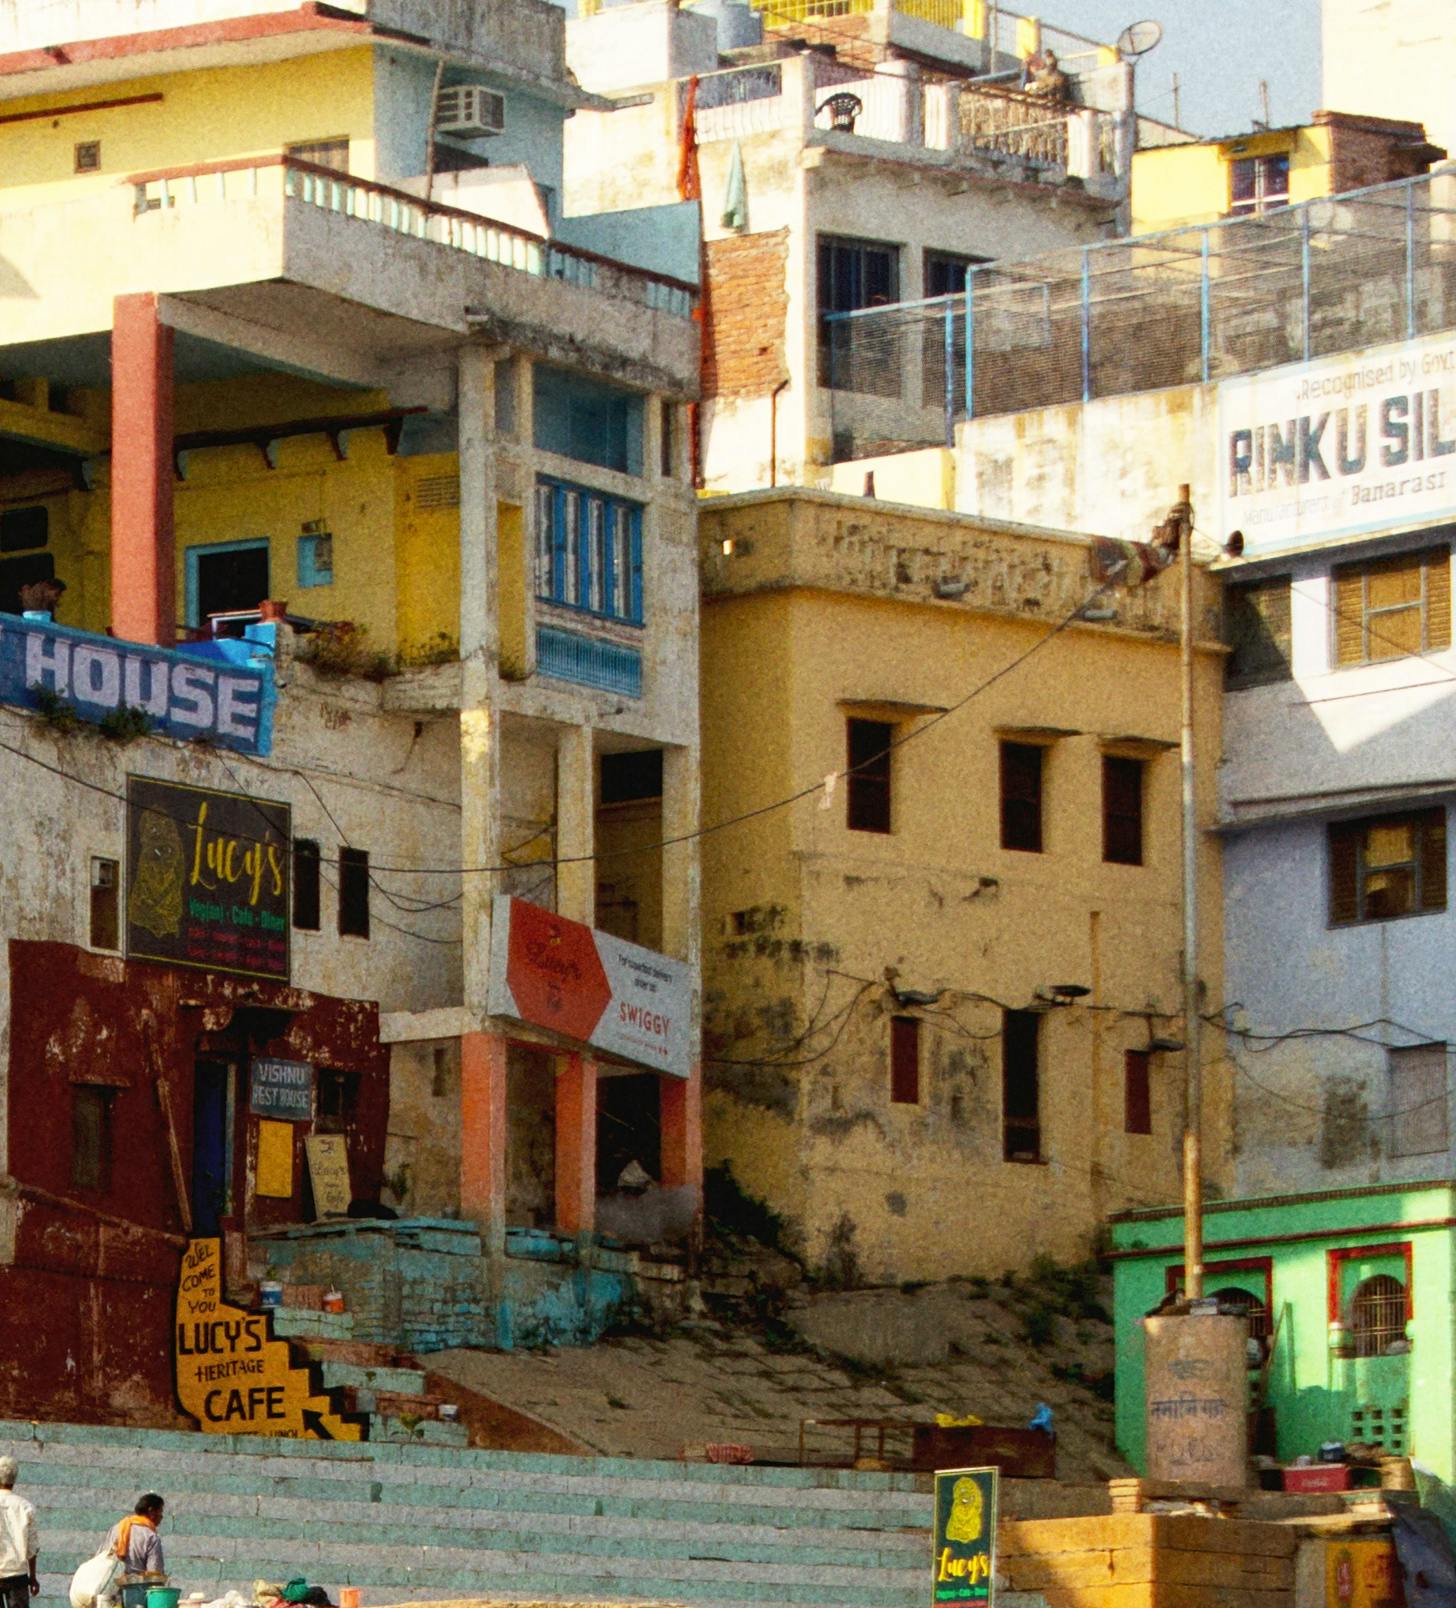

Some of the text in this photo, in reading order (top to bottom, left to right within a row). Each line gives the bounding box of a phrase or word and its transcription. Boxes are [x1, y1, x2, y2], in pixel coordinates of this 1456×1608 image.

[1399, 360, 1417, 384] by
[1229, 403, 1368, 499] RINKU
[24, 630, 262, 743] HOUSE
[189, 801, 284, 906] Lucy's
[619, 1000, 671, 1038] SWIGGY
[259, 1064, 305, 1085] VISHNU
[181, 1263, 216, 1292] COME
[188, 1300, 217, 1314] YOU
[178, 1317, 262, 1355] LUCY'S
[194, 1359, 265, 1383] HERITAGE
[204, 1386, 287, 1423] CAFE
[937, 1547, 989, 1585] Lucy's
